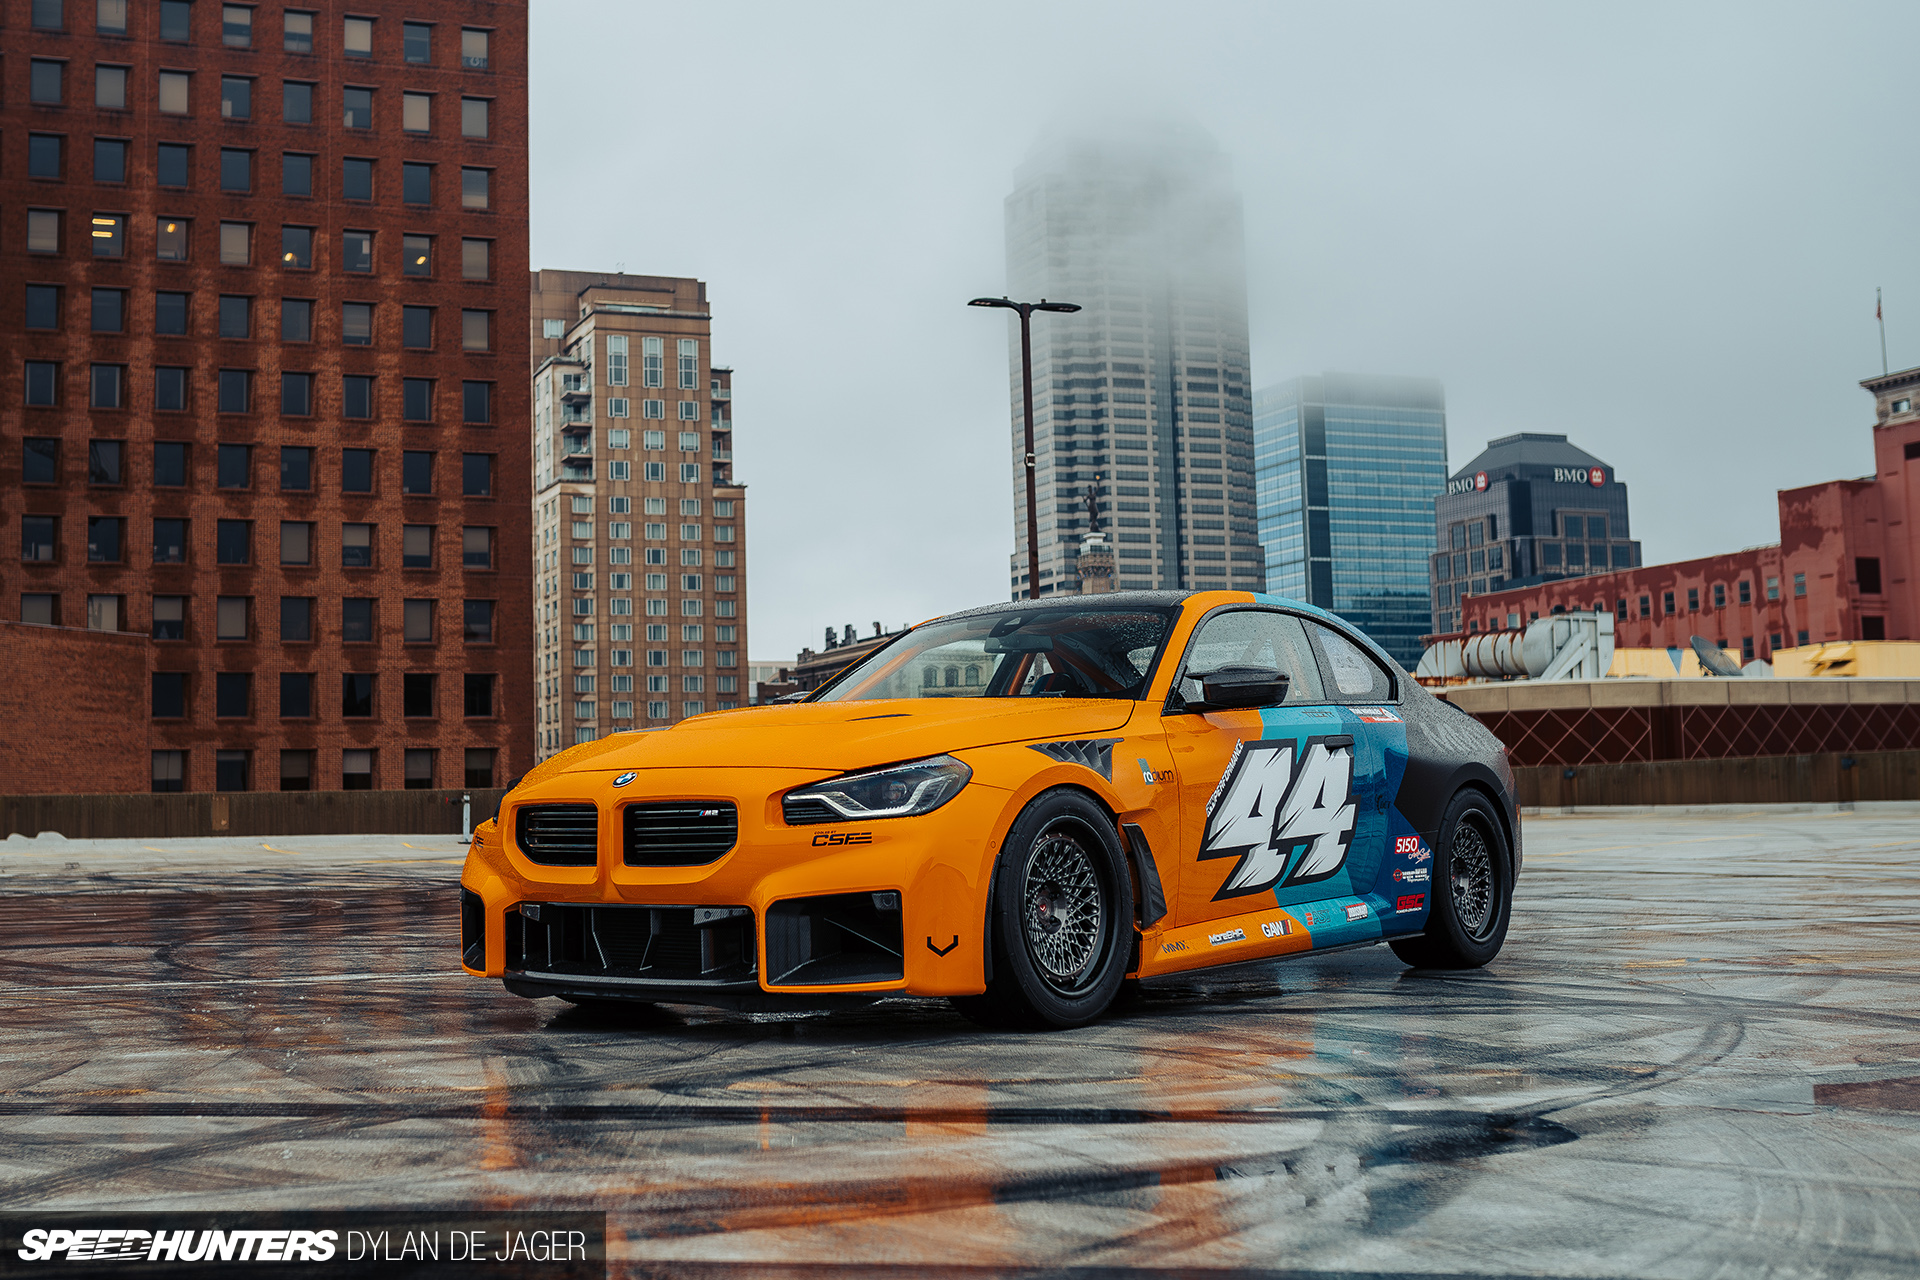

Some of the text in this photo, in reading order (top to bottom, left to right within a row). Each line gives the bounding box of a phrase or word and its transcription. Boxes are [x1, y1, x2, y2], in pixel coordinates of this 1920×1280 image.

[1553, 467, 1588, 484] BMO
[1448, 476, 1474, 496] BMO
[1199, 737, 1360, 898] 44
[1396, 838, 1418, 853] 5150
[1397, 894, 1425, 910] GSC
